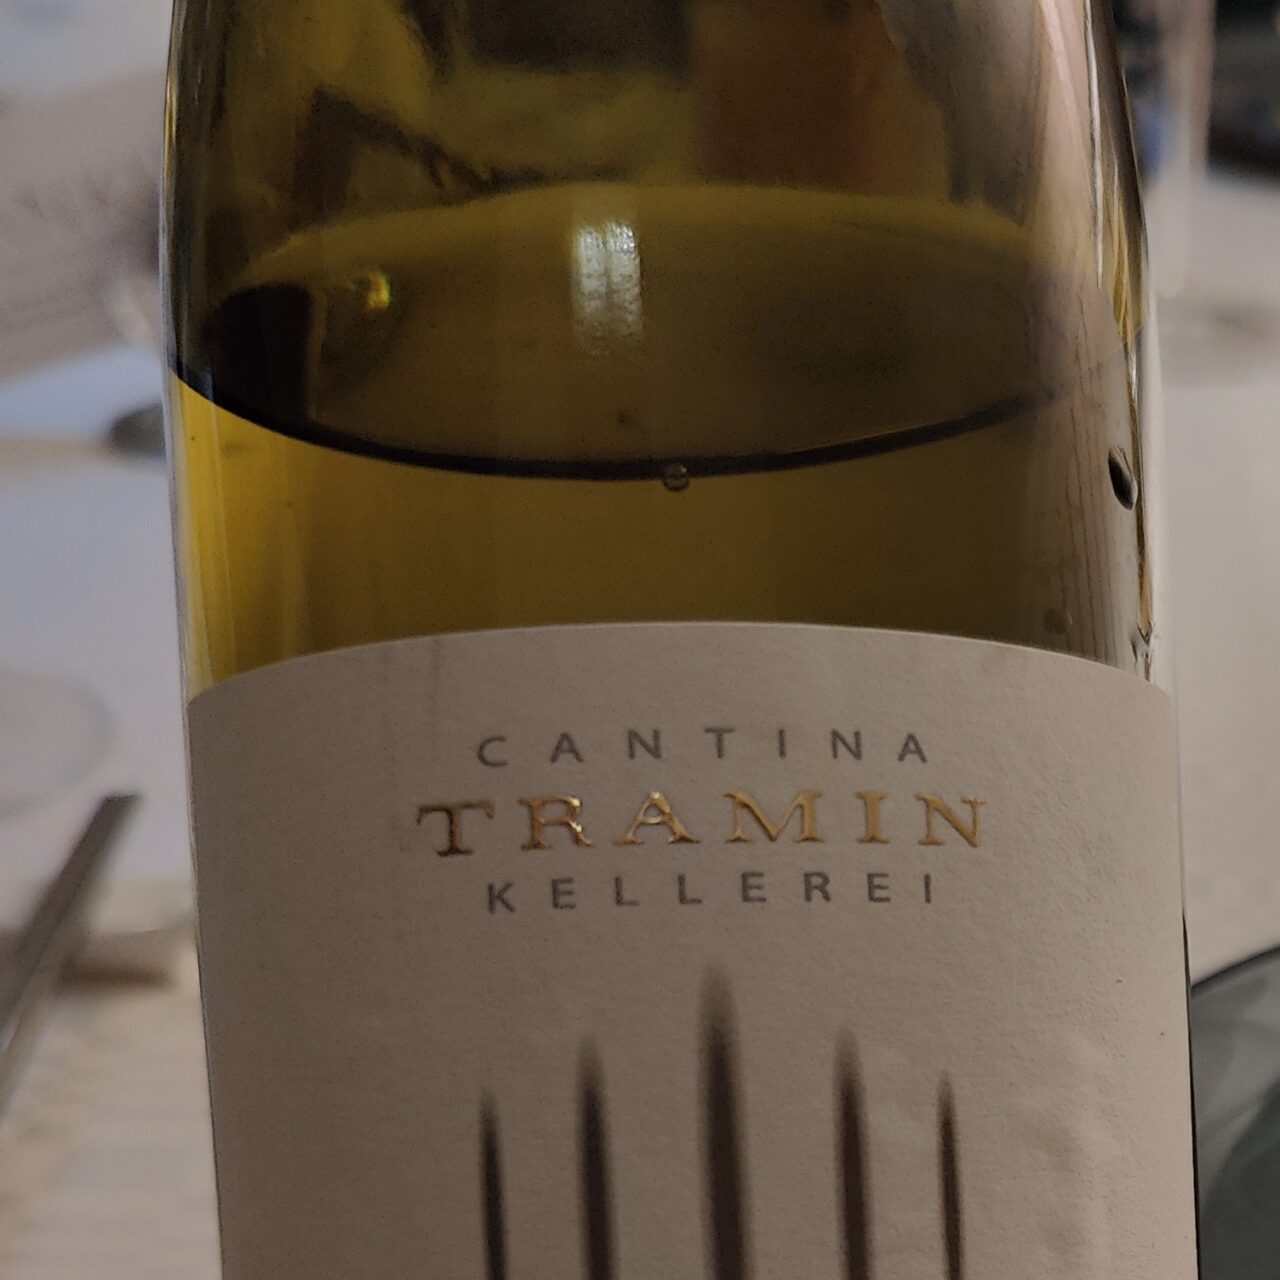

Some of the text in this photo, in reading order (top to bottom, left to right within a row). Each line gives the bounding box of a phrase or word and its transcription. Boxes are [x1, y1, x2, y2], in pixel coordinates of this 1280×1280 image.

[476, 728, 929, 768] CANTINA
[416, 790, 987, 857] TRAMIN
[486, 871, 934, 914] KELLEREI
